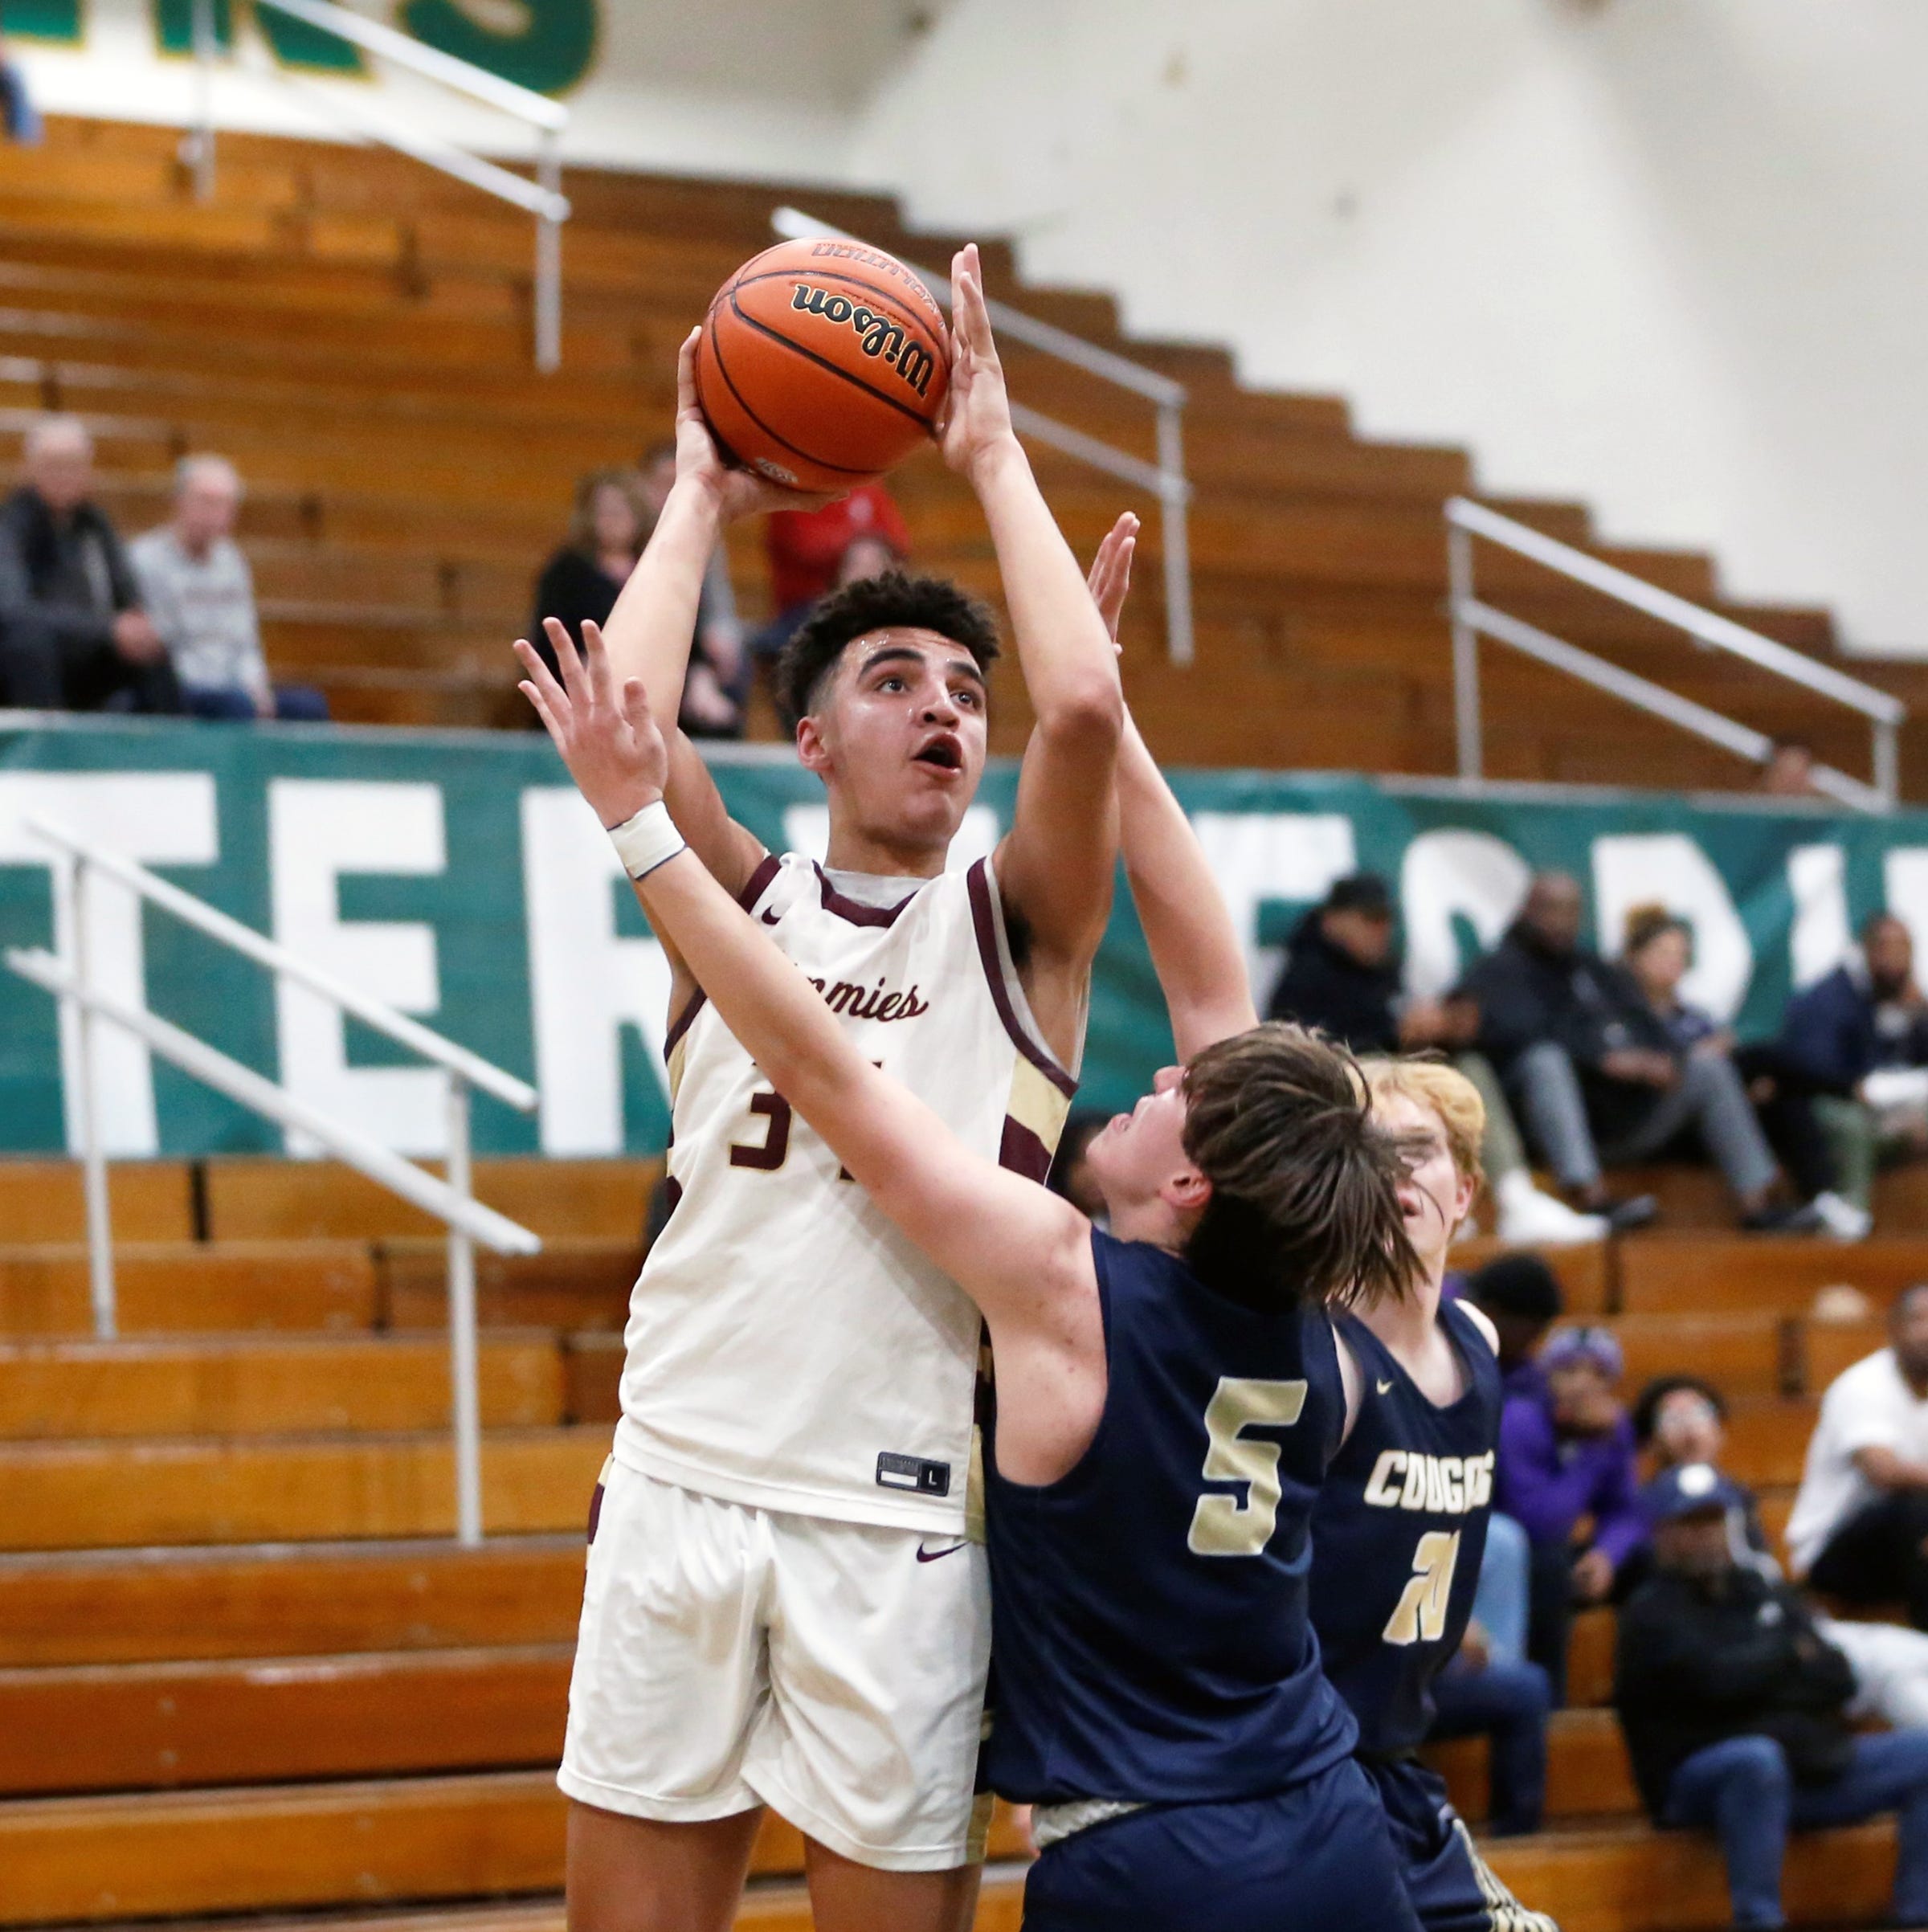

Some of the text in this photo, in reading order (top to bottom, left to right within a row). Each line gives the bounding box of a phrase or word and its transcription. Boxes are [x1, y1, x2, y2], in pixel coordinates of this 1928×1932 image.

[790, 283, 934, 399] Wilson
[928, 1469, 937, 1485] L
[1187, 1375, 1308, 1556] 5
